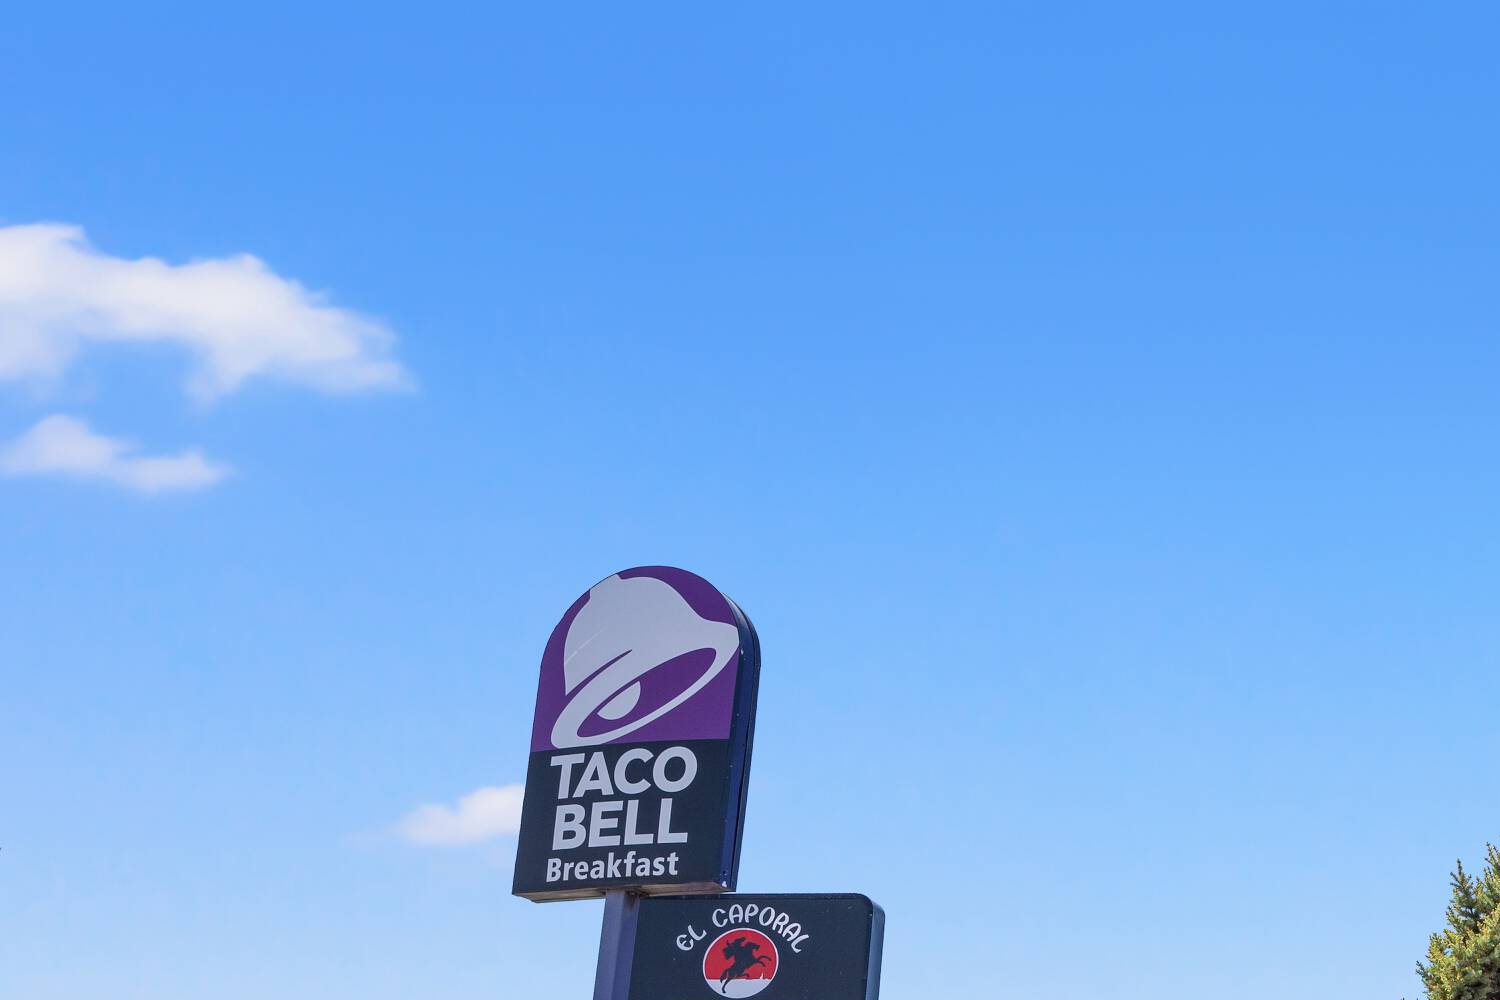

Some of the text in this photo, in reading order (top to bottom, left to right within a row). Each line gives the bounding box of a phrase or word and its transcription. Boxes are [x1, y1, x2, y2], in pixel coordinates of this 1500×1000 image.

[550, 746, 698, 799] TACO
[552, 798, 688, 850] BELL
[546, 850, 679, 882] Breakfast
[676, 903, 810, 954] EL CAPORAL
